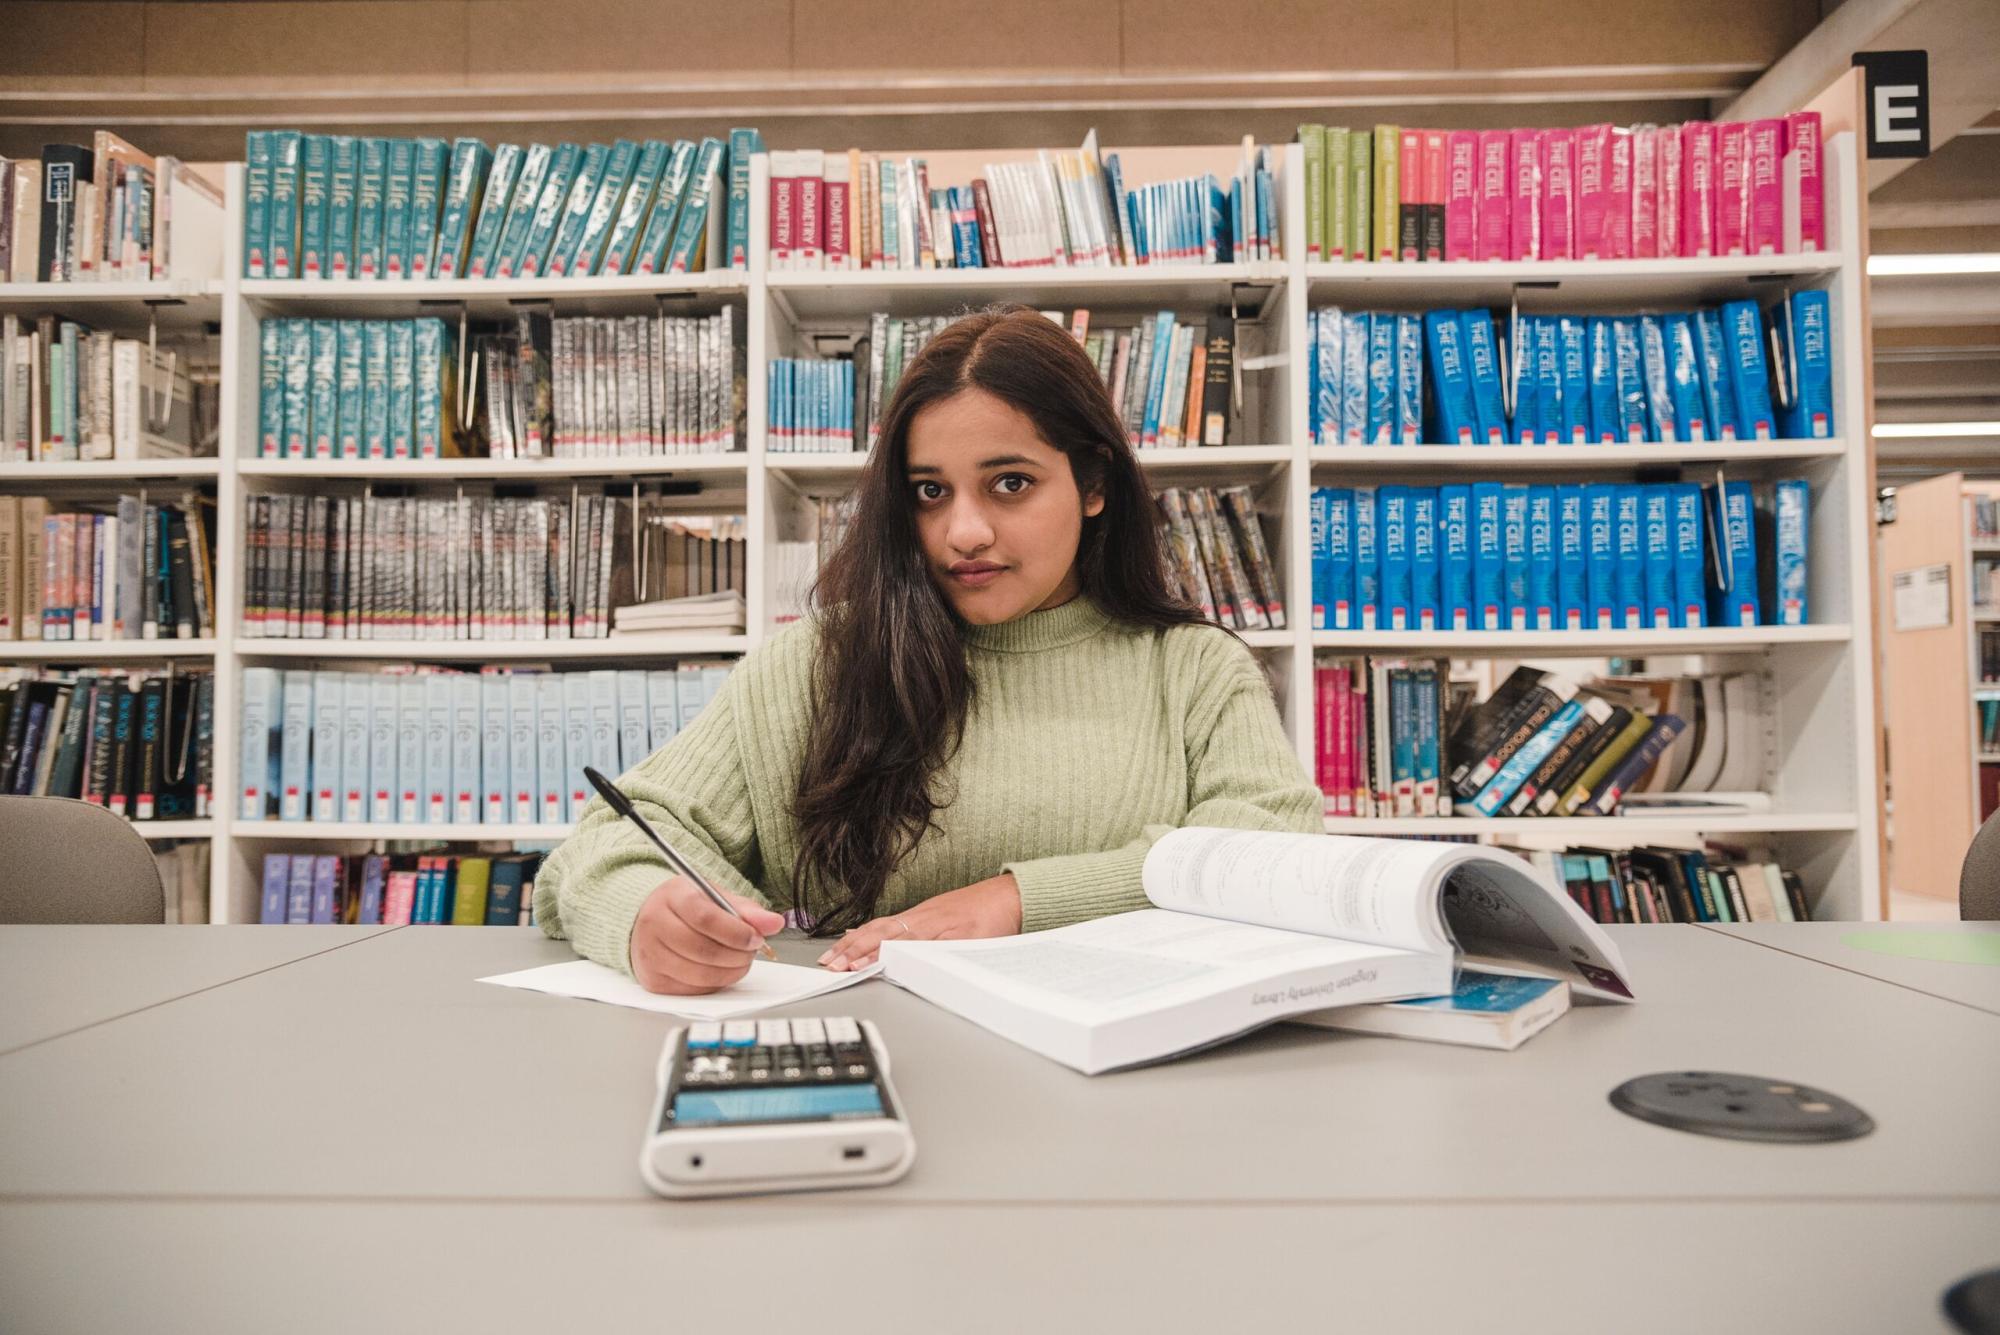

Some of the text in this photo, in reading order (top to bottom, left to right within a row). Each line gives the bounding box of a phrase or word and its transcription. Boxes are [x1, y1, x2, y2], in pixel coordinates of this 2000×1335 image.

[1874, 84, 1921, 142] E
[249, 168, 269, 203] Life
[273, 168, 295, 202] Life
[305, 172, 325, 206] Life
[332, 173, 353, 208] Life
[360, 175, 382, 208] Life
[388, 176, 409, 209] Life
[414, 175, 436, 209] Life
[777, 182, 790, 245] BIOMETRY
[802, 181, 816, 244] BIOMETRY
[830, 186, 843, 250] BIOMETRY
[1331, 500, 1344, 556] THE CELL
[1358, 501, 1371, 557] THE CELL
[1387, 498, 1400, 555] THE CELL
[1416, 500, 1428, 556] THE CELL
[1448, 497, 1461, 554] THE CELL
[1480, 496, 1493, 552] THE CELL
[1507, 498, 1520, 558] THE CELL
[1532, 497, 1545, 555] THE CELL
[1562, 497, 1575, 554] THE CELL
[1592, 497, 1605, 553] THE CELL
[1619, 497, 1632, 553] THE CELL
[1647, 497, 1661, 553] THE CELL
[1677, 495, 1692, 552] THE CELL
[247, 703, 264, 737] Life
[287, 703, 305, 737] Life
[319, 705, 338, 739] Life
[347, 706, 365, 739] Life
[375, 706, 393, 740] Life
[402, 708, 420, 740] Life
[429, 708, 448, 741] Life
[457, 708, 475, 741] Life
[486, 708, 504, 741] Life
[513, 708, 532, 741] Life
[541, 708, 560, 741] Life
[569, 707, 587, 740] Life
[594, 705, 612, 740] Life
[624, 705, 643, 739] Life
[654, 704, 672, 739] Life
[1497, 704, 1550, 761] CELL BIOLOG
[1537, 725, 1587, 785] CELL BIOLOGY
[1252, 969, 1377, 1006] Kingston University Library
